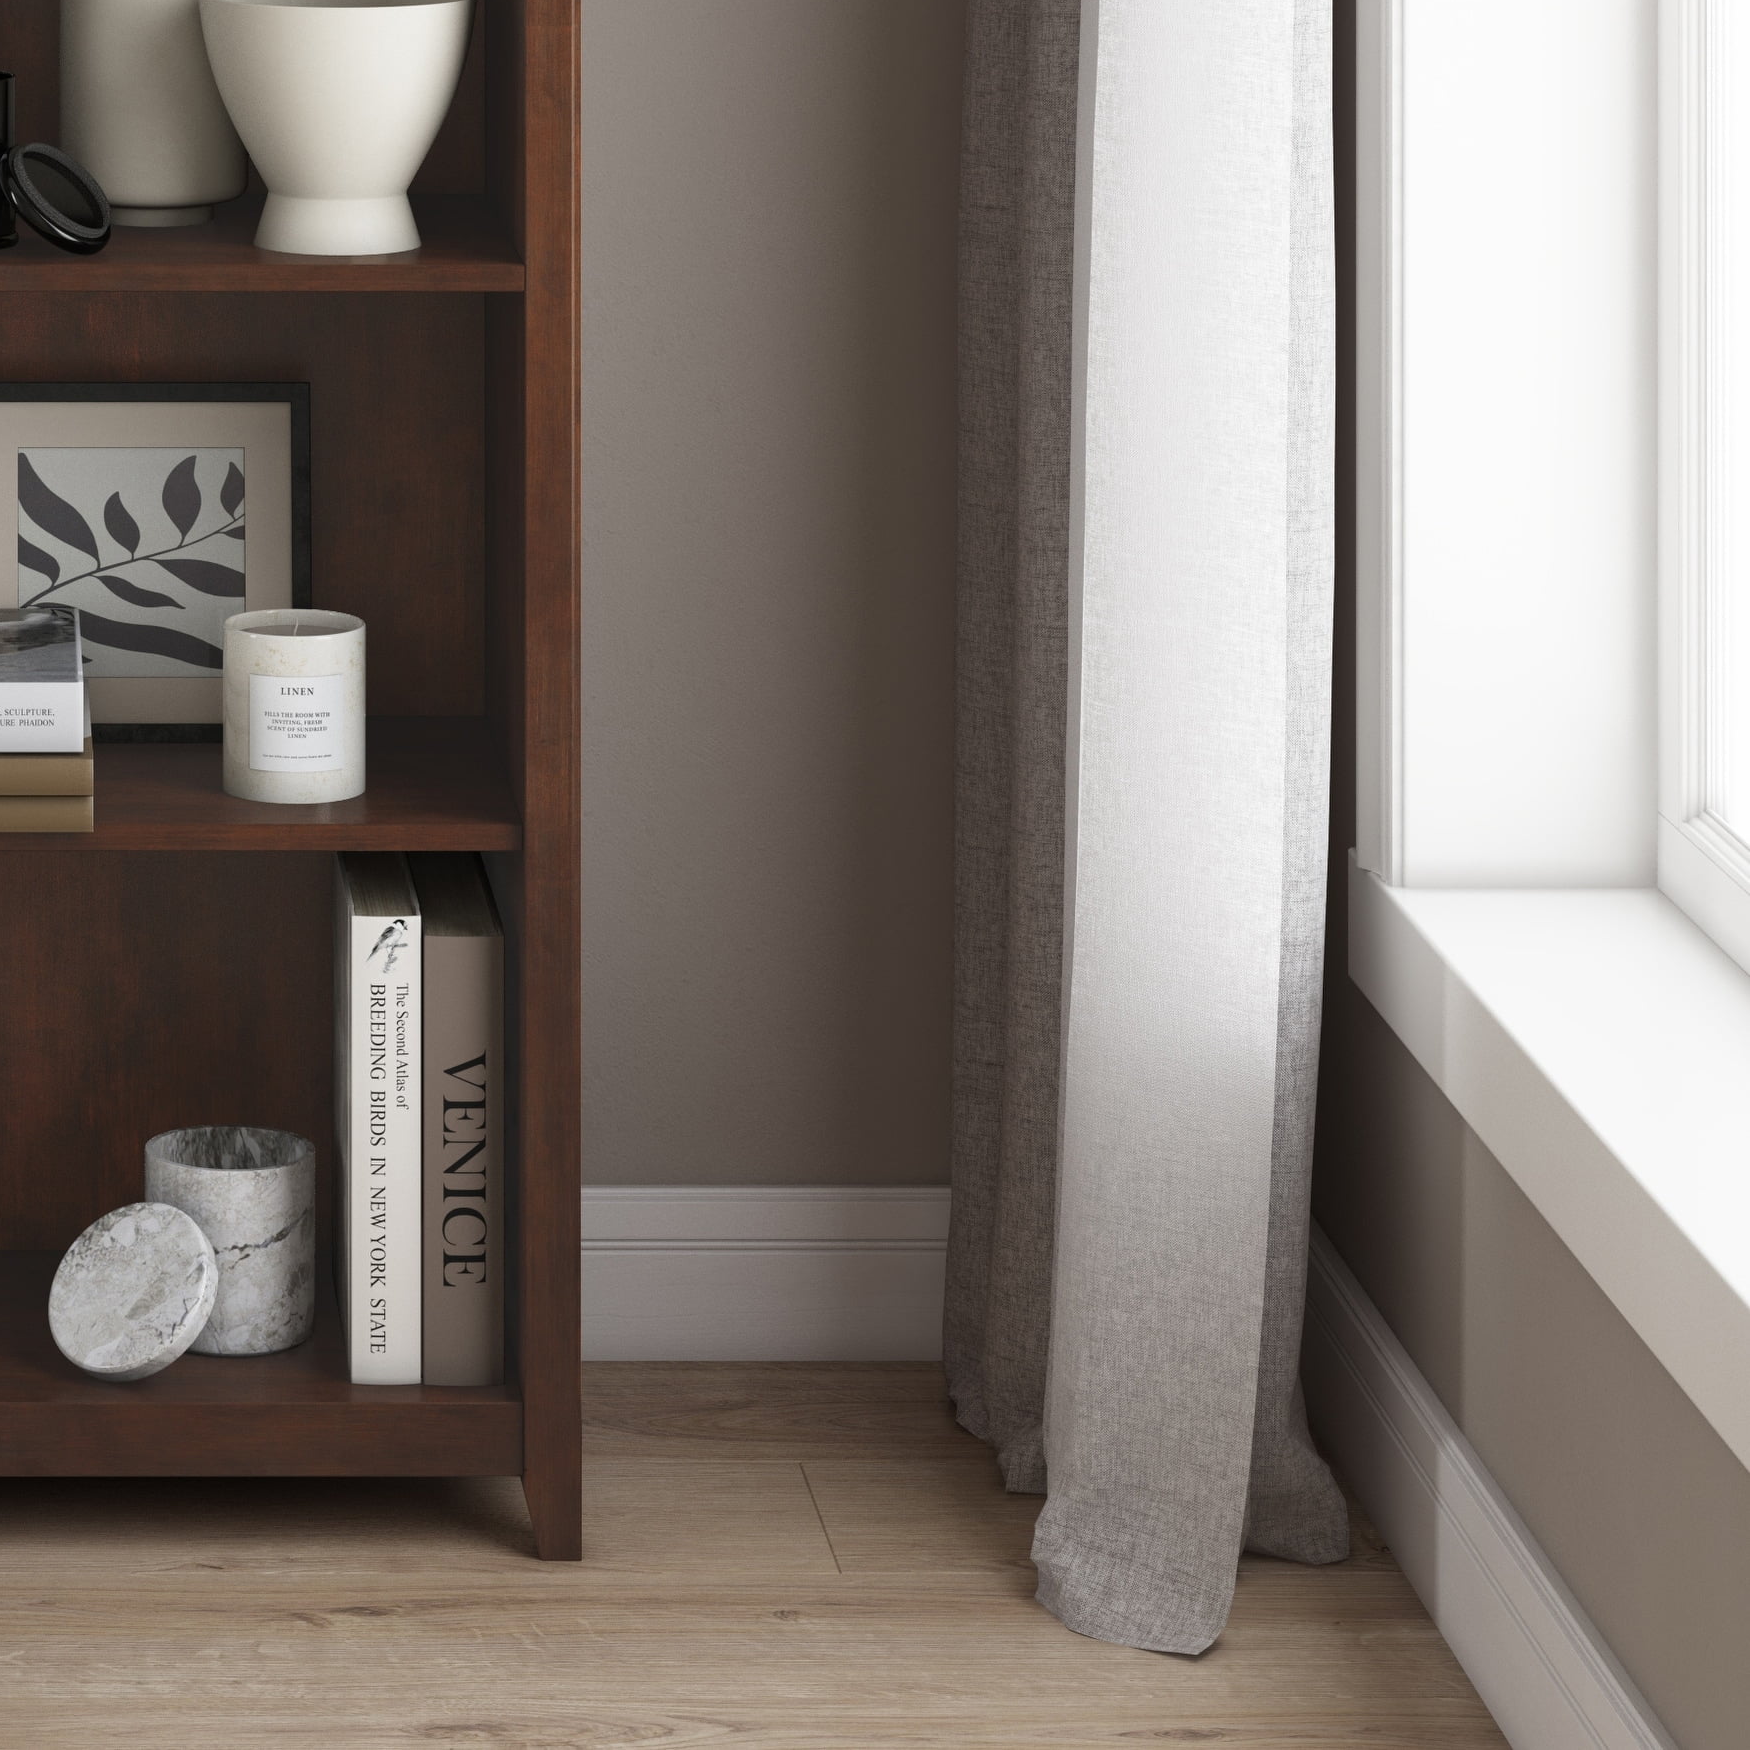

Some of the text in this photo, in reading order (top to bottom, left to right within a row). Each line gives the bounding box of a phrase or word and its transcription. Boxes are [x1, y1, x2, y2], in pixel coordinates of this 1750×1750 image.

[281, 687, 313, 695] LINEN
[396, 983, 409, 1110] The Second Atlas of
[370, 985, 386, 1353] BREEDING BIRDS IN NEW YORK STATE
[442, 1050, 487, 1287] VENICE
